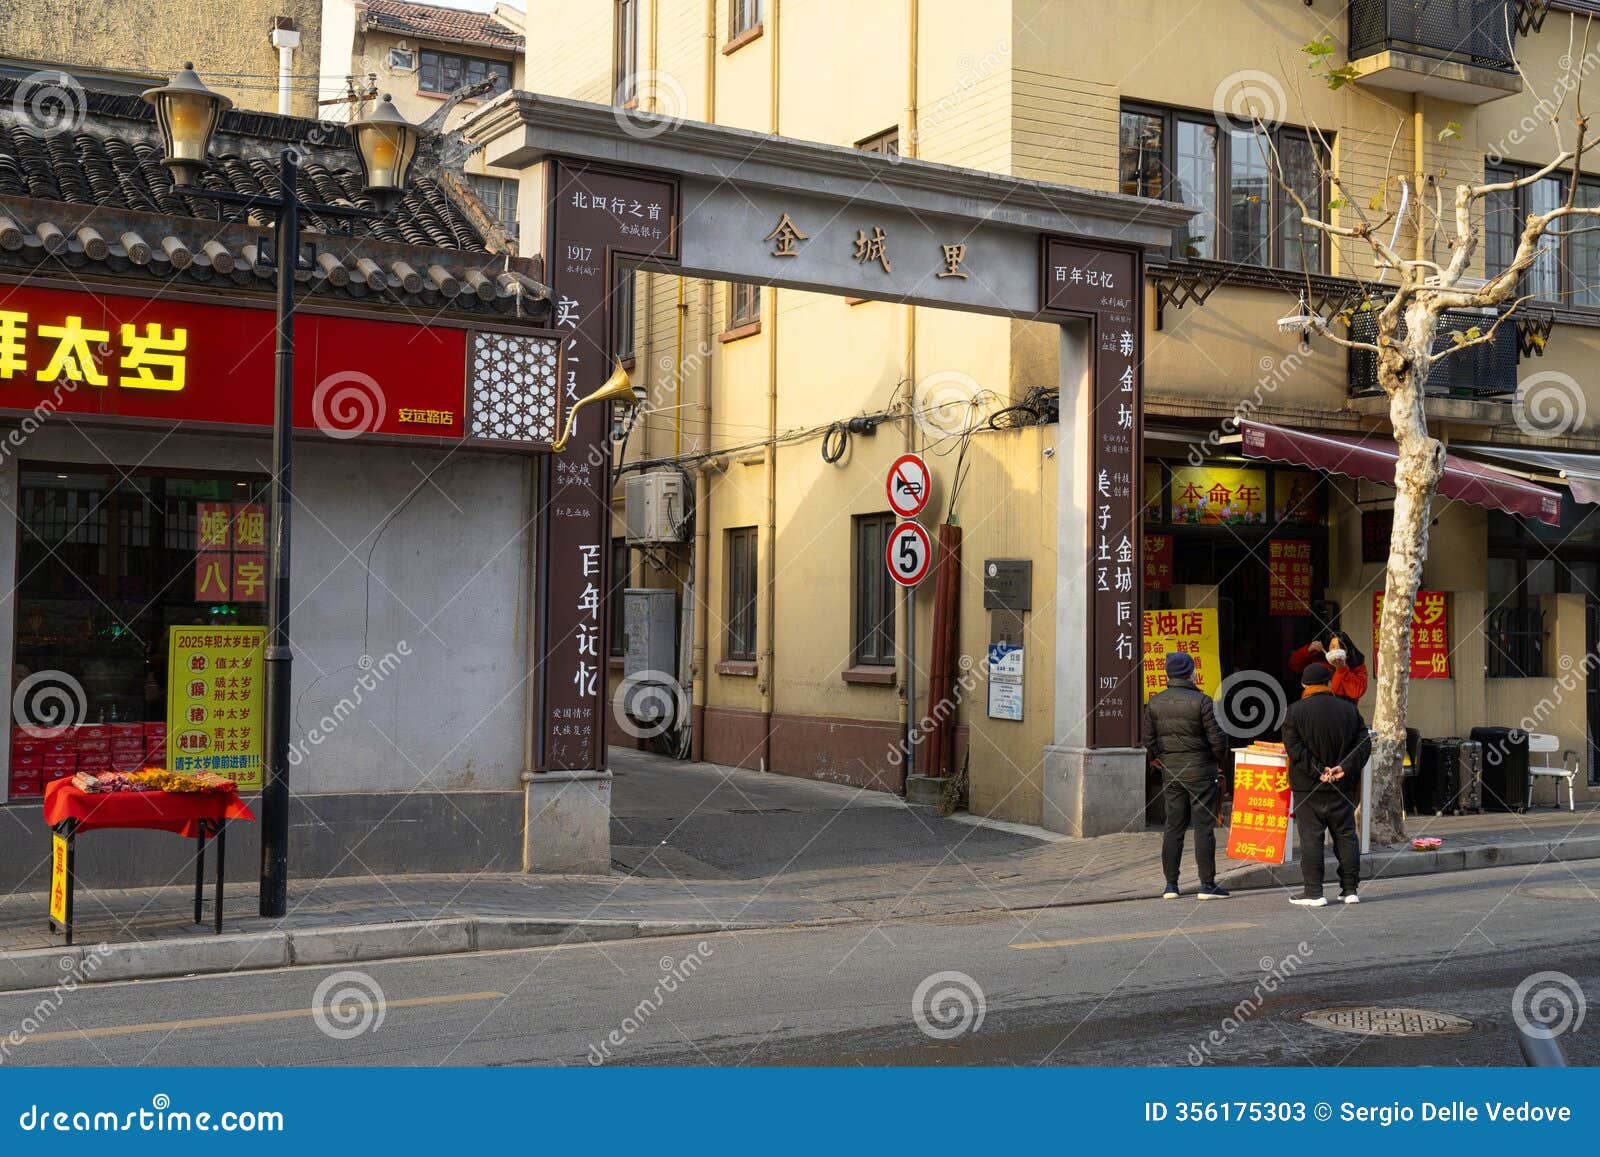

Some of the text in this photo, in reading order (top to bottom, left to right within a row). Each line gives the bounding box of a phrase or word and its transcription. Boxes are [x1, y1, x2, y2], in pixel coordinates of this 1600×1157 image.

[572, 192, 662, 220] 北四行之首
[567, 246, 592, 261] 1917
[764, 213, 969, 279] 金城里
[1054, 266, 1114, 288] 百年记忆
[398, 407, 454, 425] 安远路店
[1178, 482, 1261, 505] 本命年
[201, 510, 264, 545] 婚姻
[899, 536, 918, 573] 5
[200, 561, 265, 596] 八字
[178, 635, 260, 648] 2025年犯太岁生肖
[191, 656, 252, 670] 蛇 值太岁
[1099, 677, 1118, 688] 1917
[190, 708, 250, 722] 猪 冲太岁
[552, 708, 592, 719] 爱国情怀
[552, 725, 592, 736] 民族复兴
[1234, 768, 1290, 793] 拜太岁
[1248, 797, 1275, 808] 2025年
[1235, 842, 1275, 858] 20元一份
